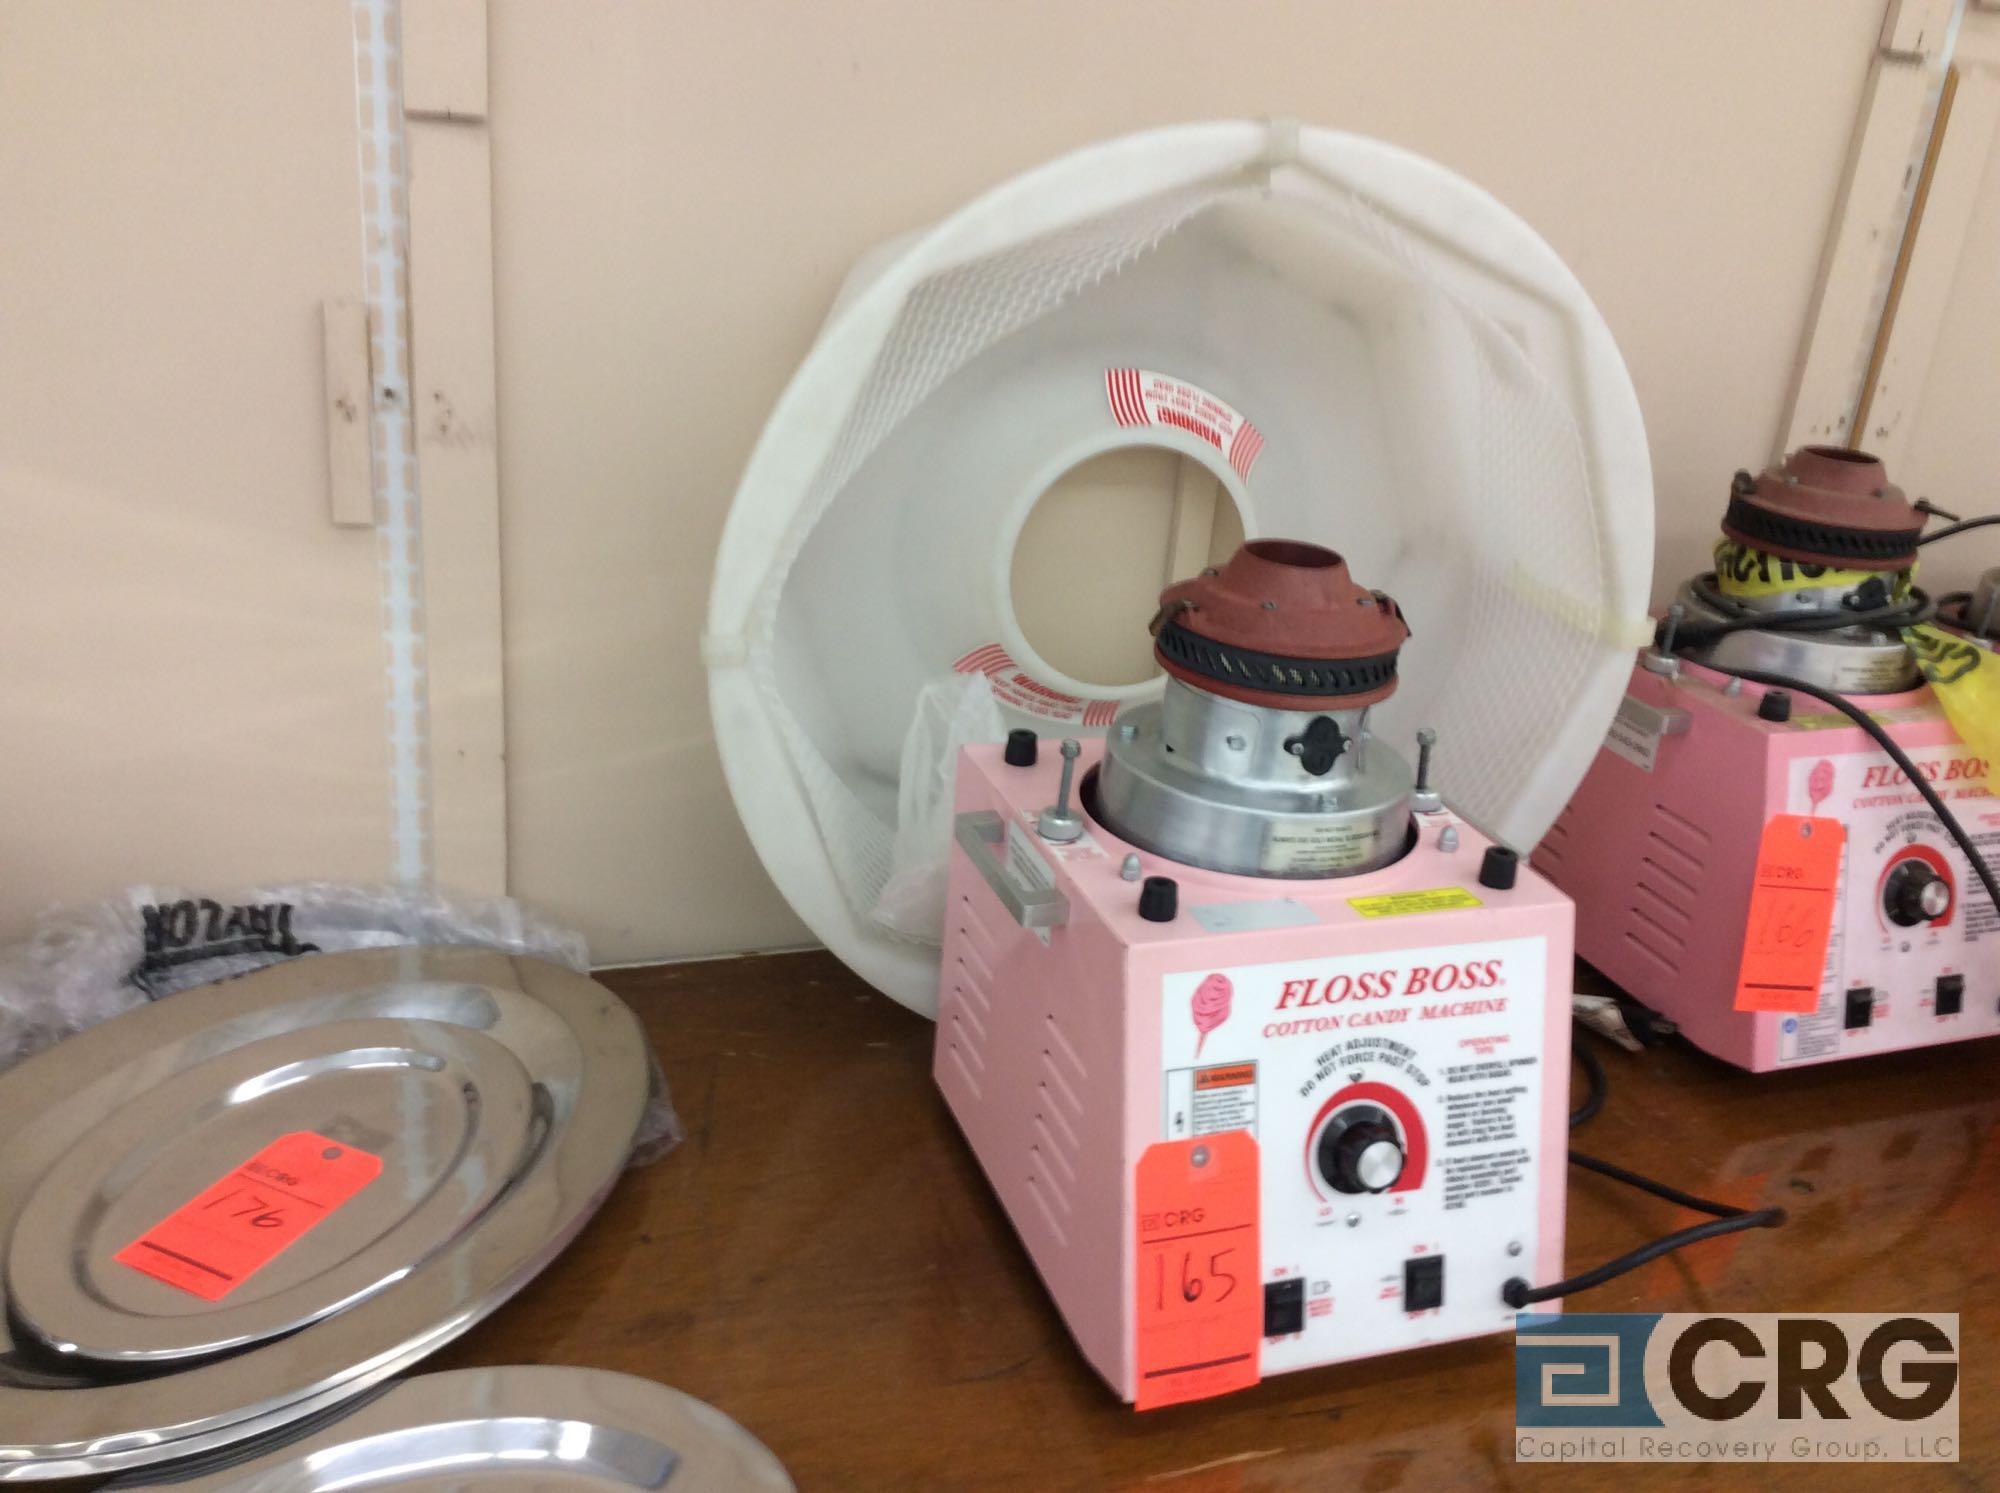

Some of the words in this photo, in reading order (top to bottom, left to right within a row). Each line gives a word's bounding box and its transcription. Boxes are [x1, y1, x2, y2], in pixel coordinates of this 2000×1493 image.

[1275, 970, 1397, 1010] FLOSS
[1403, 959, 1503, 996] BOSS
[1262, 1014, 1344, 1038] COTTON
[1348, 1008, 1412, 1028] CANDY
[1419, 998, 1508, 1021] MACHINE
[1315, 1062, 1337, 1081] NOT
[1340, 1051, 1375, 1067] FORCE
[201, 1188, 285, 1228] 176
[1164, 1207, 1206, 1228] CRG
[1157, 1248, 1236, 1310] 165
